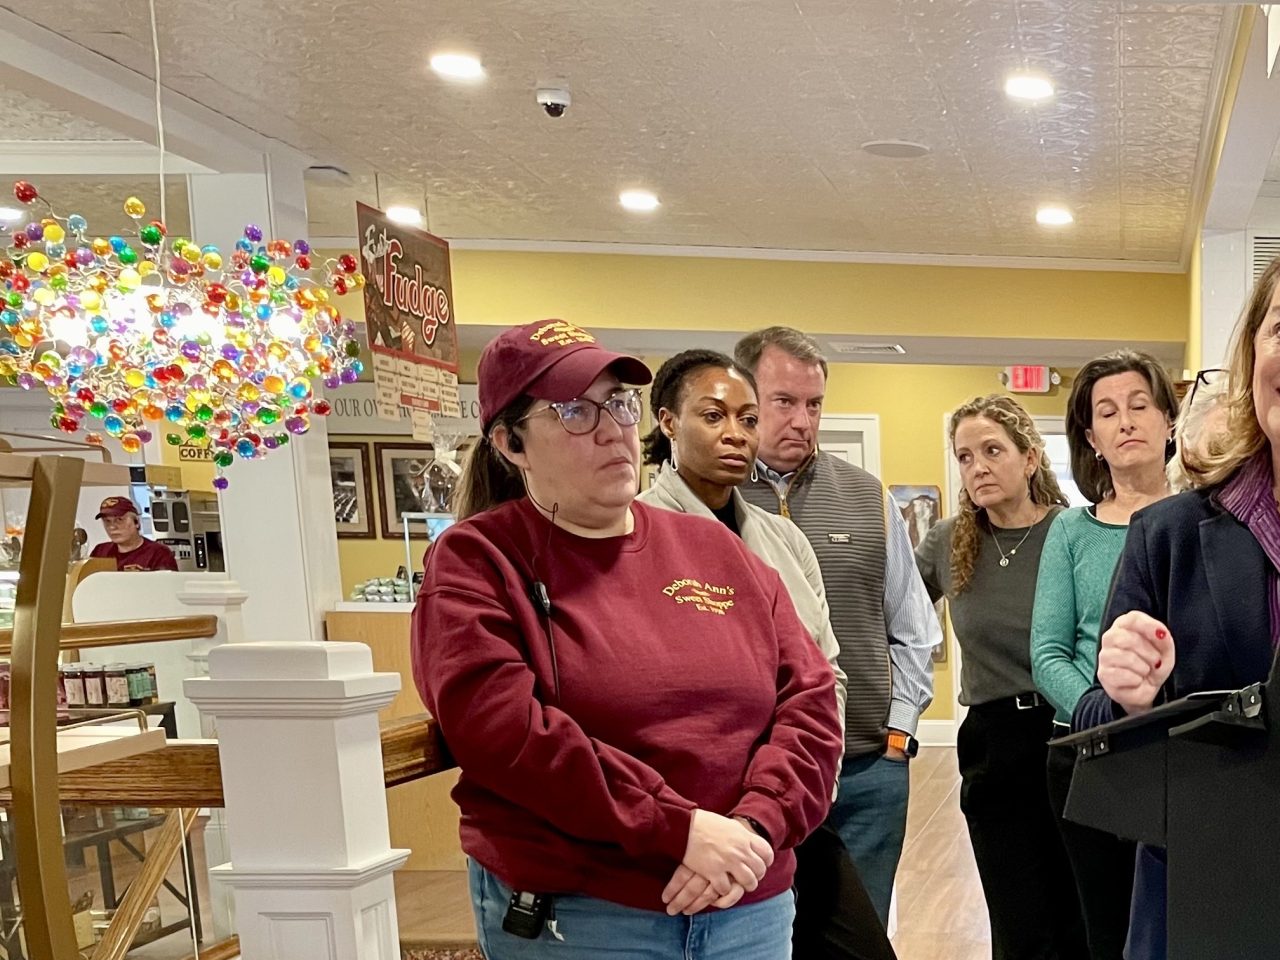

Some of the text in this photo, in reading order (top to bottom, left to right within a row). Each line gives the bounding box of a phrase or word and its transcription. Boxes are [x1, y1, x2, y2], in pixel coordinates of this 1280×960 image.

[384, 239, 449, 345] Fudge
[335, 399, 360, 417] OUR
[180, 448, 214, 459] COFF
[704, 582, 735, 596] Ann's
